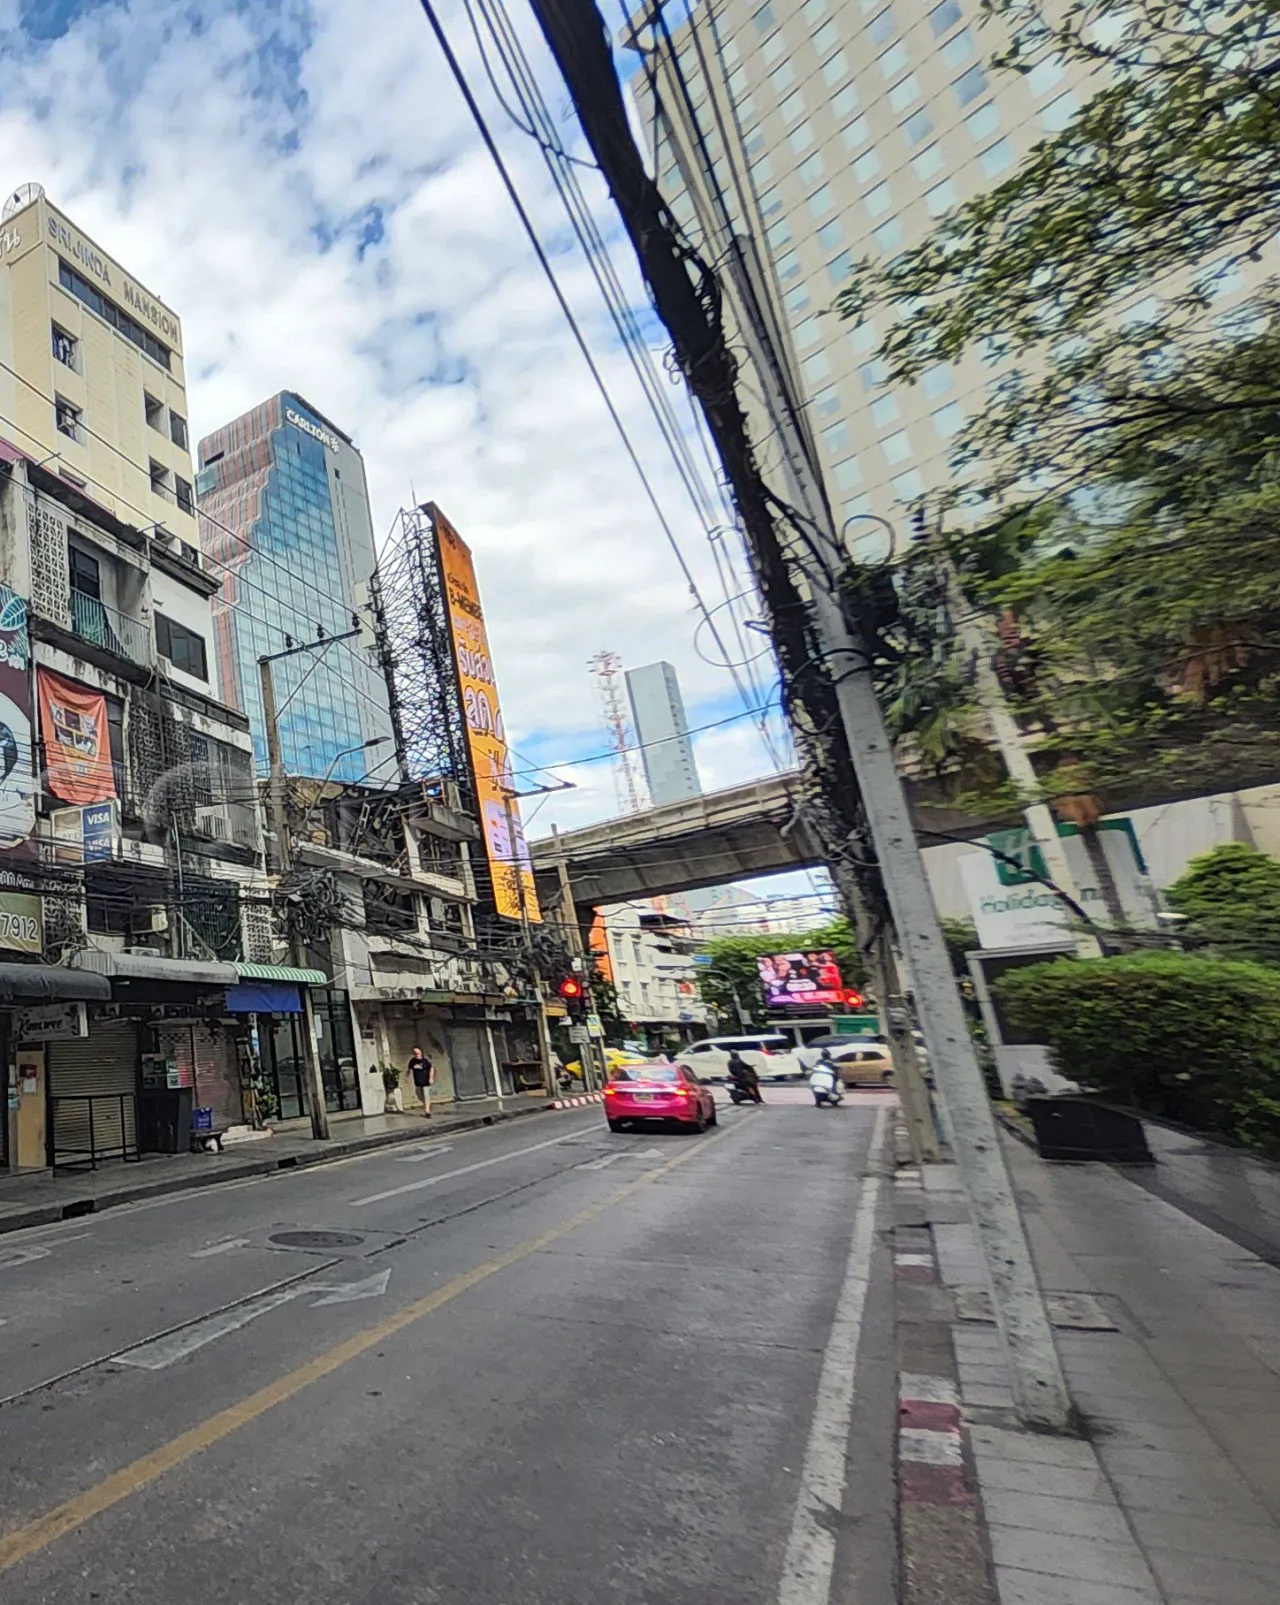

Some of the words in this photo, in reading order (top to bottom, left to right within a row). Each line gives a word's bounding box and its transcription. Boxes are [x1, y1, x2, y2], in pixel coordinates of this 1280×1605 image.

[123, 281, 179, 343] MANSION
[286, 408, 330, 446] CARLTON
[87, 812, 110, 825] VISA
[0, 912, 39, 942] 7912
